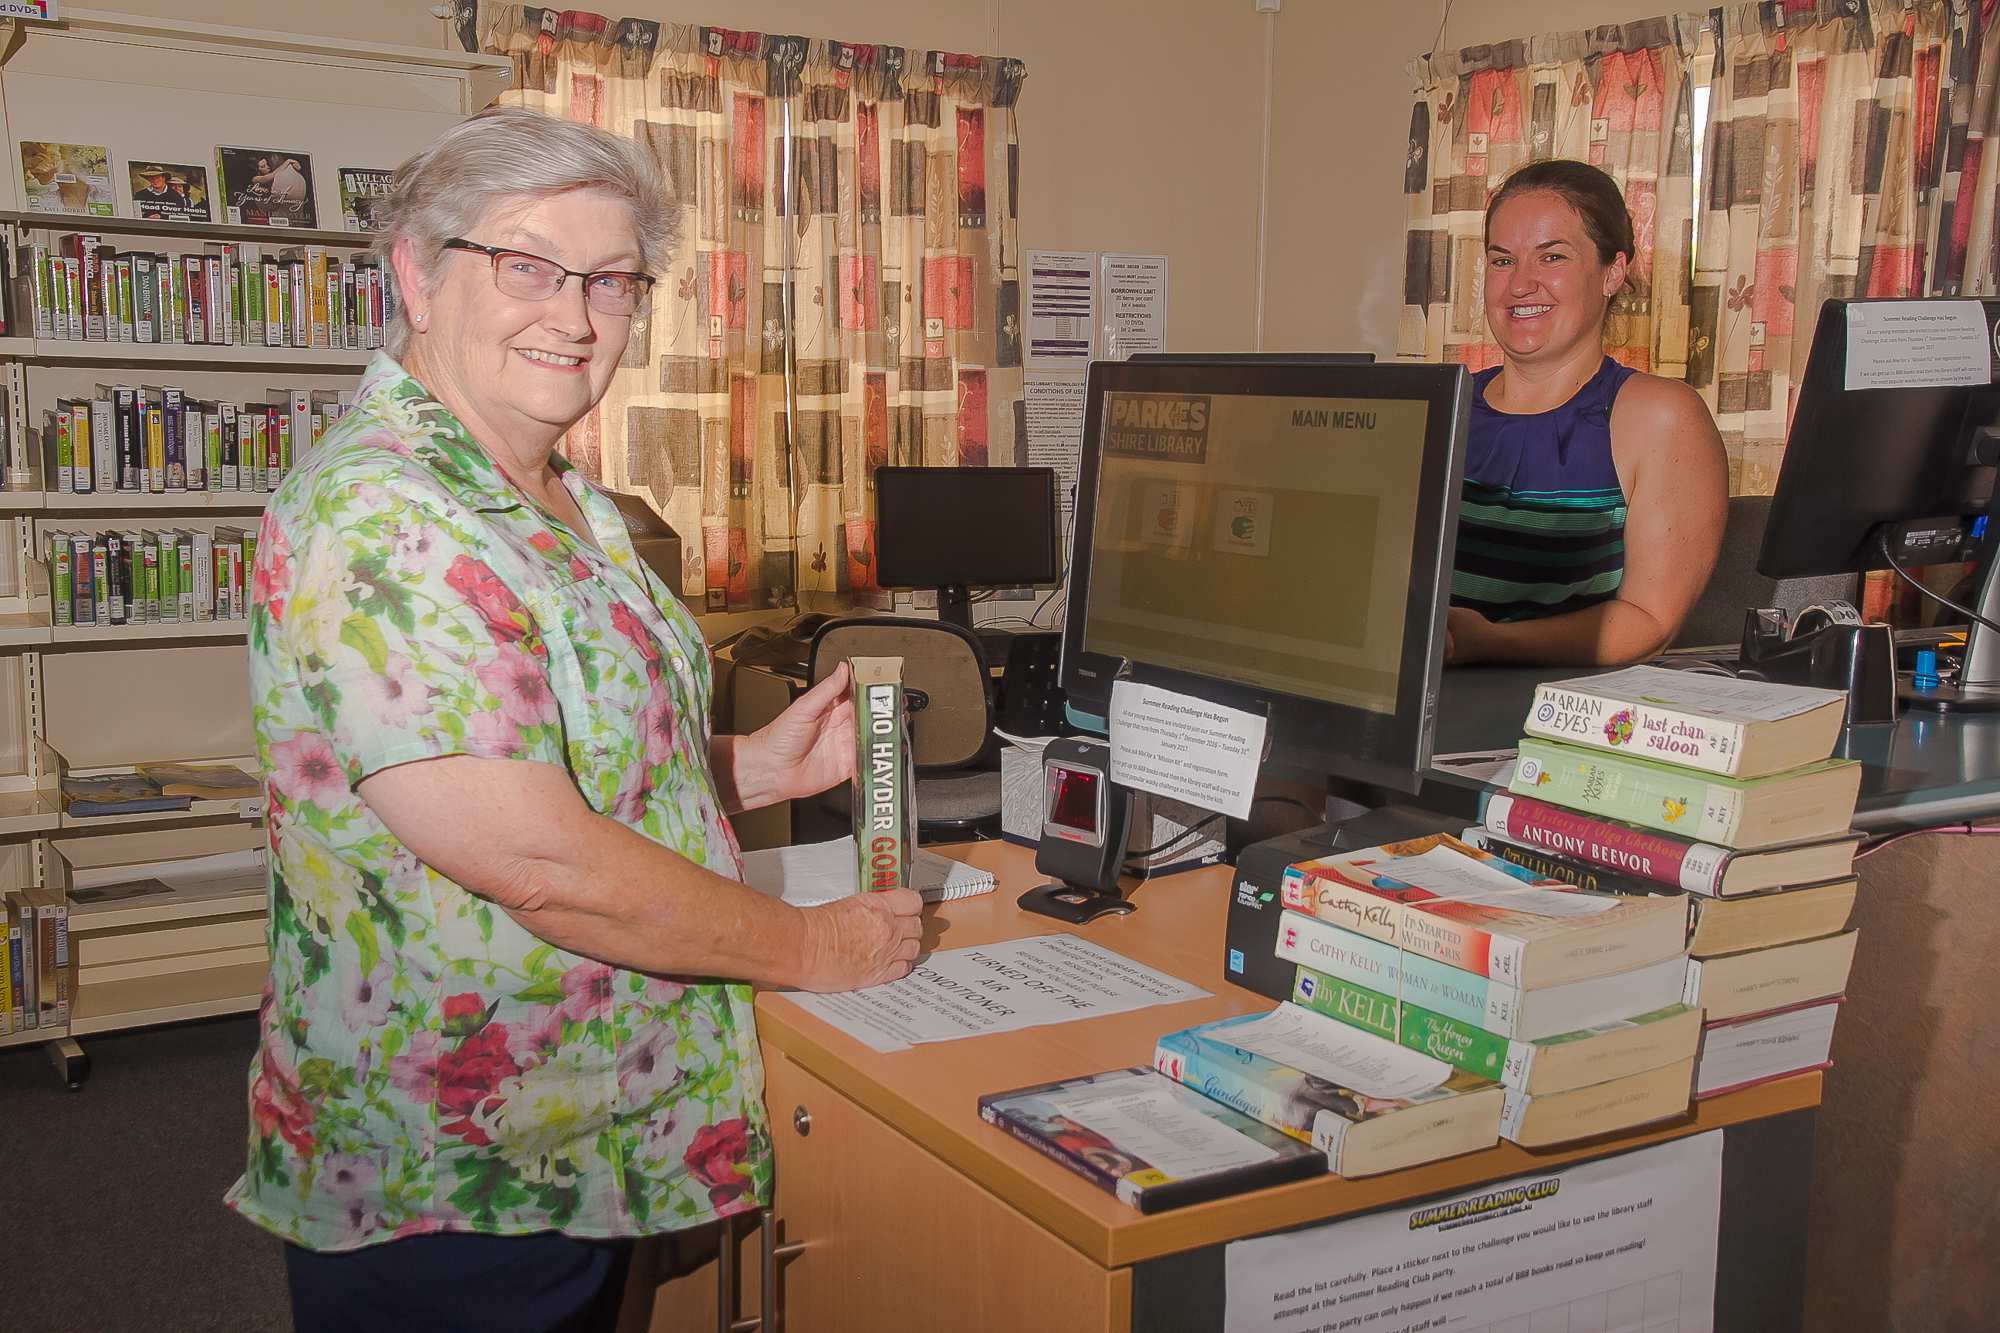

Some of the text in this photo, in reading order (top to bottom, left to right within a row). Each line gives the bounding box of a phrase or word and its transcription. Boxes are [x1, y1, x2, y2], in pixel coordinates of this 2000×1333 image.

[9, 4, 38, 15] DVDs
[355, 173, 393, 184] VILLAG
[1111, 400, 1207, 431] PARKES
[1291, 409, 1377, 430] MAIN MENU
[1110, 432, 1202, 454] SHIRE LIBRARY
[1142, 698, 1162, 708] Summer
[1161, 702, 1181, 713] Reading
[1180, 706, 1203, 719] Challenge
[1212, 714, 1229, 725] Begun
[1553, 711, 1591, 734] EYES
[1643, 713, 1705, 740] last chan
[1646, 734, 1700, 757] saloon
[1720, 736, 1730, 754] KEY
[871, 743, 896, 831] HAYDER
[1581, 764, 1597, 803] MARIAN
[871, 836, 897, 893] GON
[1522, 824, 1585, 855] ANTONY
[1591, 843, 1652, 875] BEEVOR
[1318, 889, 1396, 940] Cathy Kelly
[1419, 918, 1462, 945] STARTED
[1434, 940, 1461, 961] PARIS
[965, 951, 1096, 1010] TURNED OFF THE
[975, 978, 1011, 992] AIR
[1310, 938, 1347, 962] CATHY
[1350, 951, 1382, 974] KELLY
[1441, 983, 1485, 1009] WOMAN
[913, 966, 1017, 1016] CONDITIONER
[1316, 981, 1407, 1038] thy KELLY
[1424, 1017, 1473, 1048] The Honey
[1427, 1033, 1465, 1062] Queen
[1202, 1075, 1263, 1116] Gundagai
[1409, 1178, 1560, 1230] SUMMER READING CLUB
[1273, 1288, 1296, 1302] Read
[1298, 1286, 1312, 1296] the
[1314, 1281, 1328, 1292] list
[1372, 1264, 1393, 1277] Place
[1403, 1257, 1430, 1270] sticker
[1432, 1252, 1449, 1262] next
[1452, 1249, 1460, 1257] to
[1462, 1243, 1476, 1254] the
[1477, 1235, 1515, 1250] challenge
[1517, 1231, 1531, 1242] you
[1533, 1223, 1556, 1236] would
[1558, 1220, 1570, 1230] like
[1573, 1217, 1581, 1225] to
[1583, 1215, 1595, 1223] see
[1597, 1211, 1610, 1220] the
[1612, 1203, 1635, 1217] library
[1637, 1197, 1653, 1209] staff
[1273, 1268, 1456, 1321] attempt at the Summer Reading Club party.
[1323, 1319, 1337, 1332] the
[1339, 1315, 1362, 1331] party
[1364, 1312, 1379, 1322] can
[1381, 1306, 1399, 1318] only
[1401, 1297, 1432, 1312] happen
[1433, 1293, 1440, 1303] if
[1440, 1290, 1453, 1301] we
[1455, 1285, 1477, 1298] reach
[1485, 1275, 1504, 1288] total
[1505, 1272, 1514, 1283] of
[1531, 1262, 1554, 1277] books
[1556, 1258, 1573, 1270] read
[1585, 1251, 1604, 1262] keep
[1605, 1249, 1615, 1257] on
[1616, 1238, 1647, 1254] reading!
[1411, 1319, 1431, 1332] staff
[1432, 1315, 1448, 1327] will
